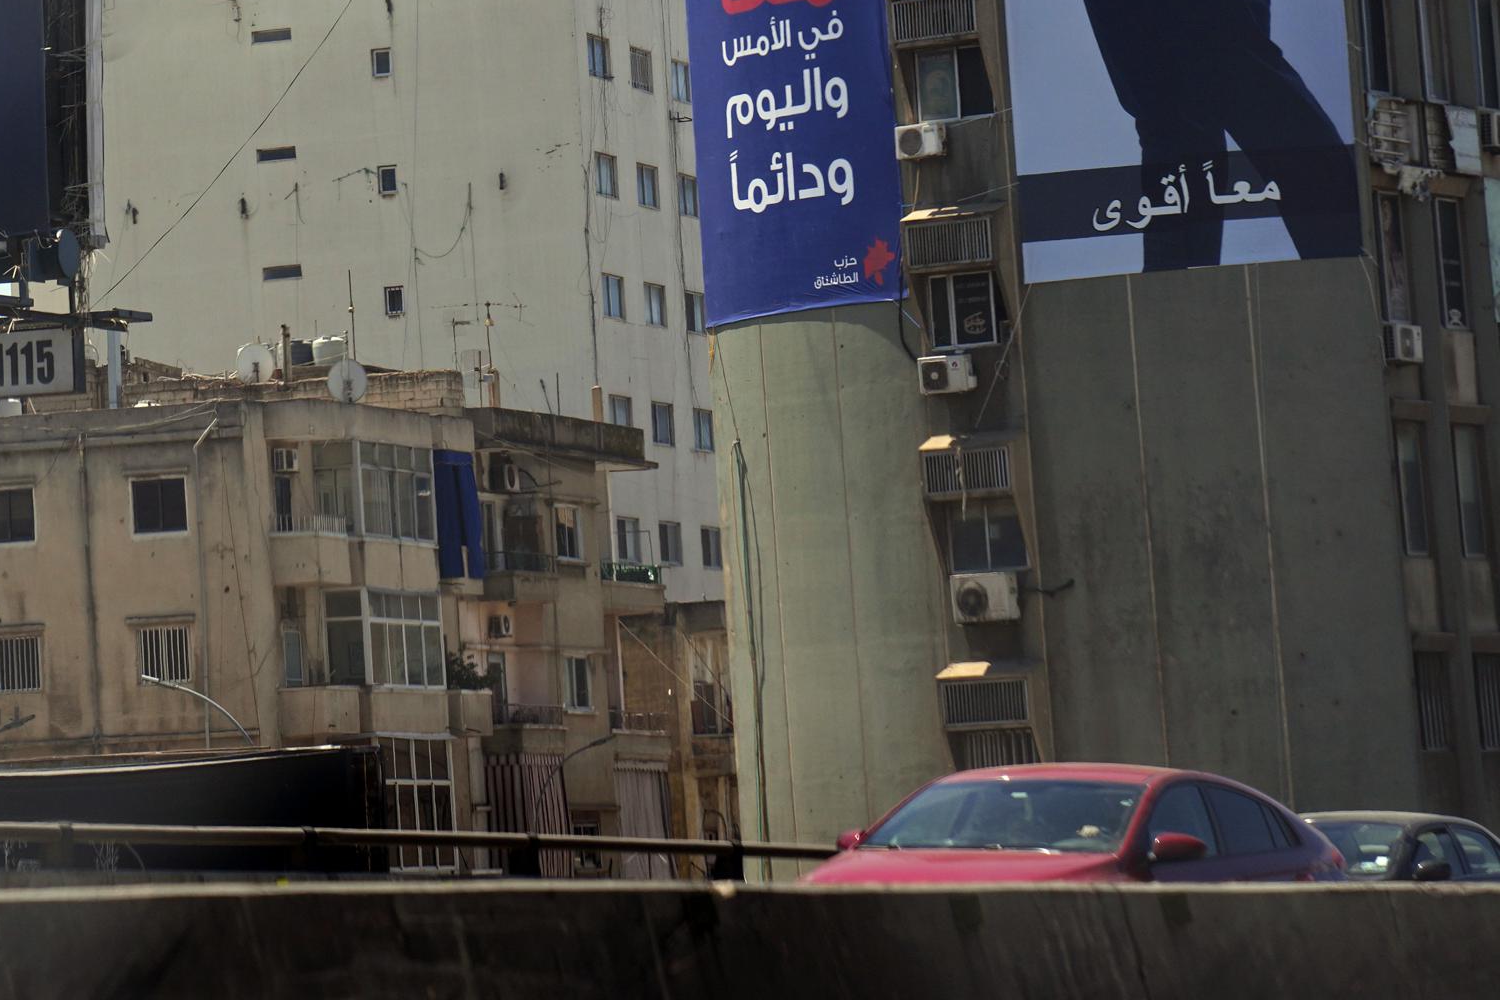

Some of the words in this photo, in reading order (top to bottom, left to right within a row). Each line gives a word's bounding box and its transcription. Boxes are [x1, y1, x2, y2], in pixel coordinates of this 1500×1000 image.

[721, 15, 792, 67] الأمس
[798, 9, 844, 60] في
[725, 66, 849, 139] واليوم
[728, 149, 855, 214] ودائماً
[1092, 163, 1191, 232] أقوى
[1201, 159, 1282, 205] معاً
[813, 271, 859, 290] الطاشناق
[833, 255, 857, 270] حزب
